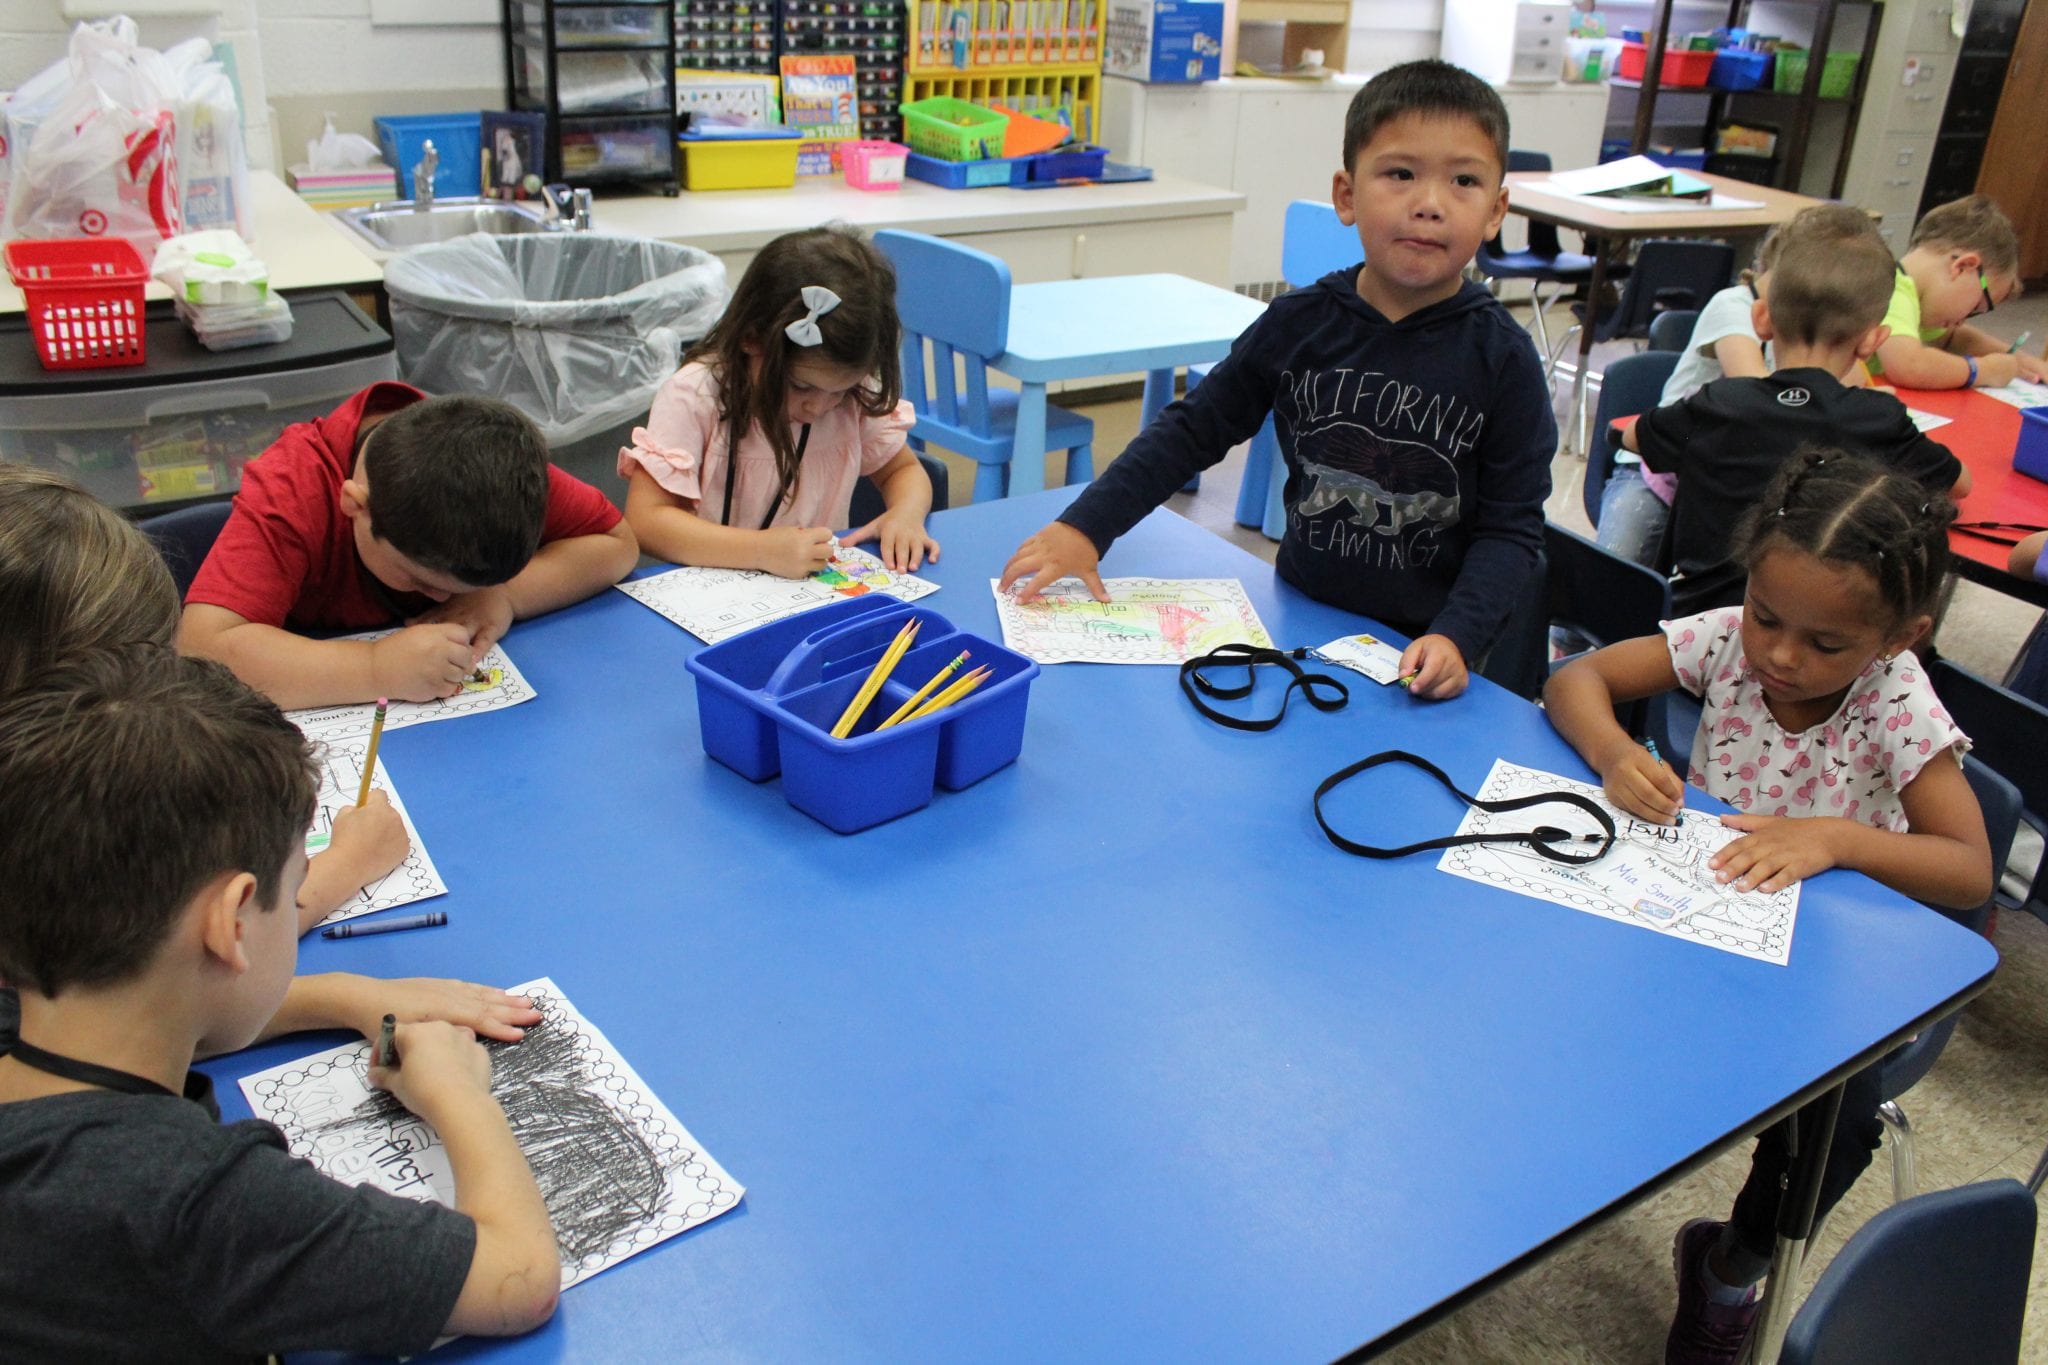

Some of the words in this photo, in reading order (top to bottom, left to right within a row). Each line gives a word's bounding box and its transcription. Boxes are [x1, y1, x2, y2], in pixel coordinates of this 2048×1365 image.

[1609, 863, 1638, 885] Mia
[1645, 883, 1692, 912] Smith
[1645, 857, 1658, 868] My
[1661, 866, 1688, 885] Name
[369, 1139, 434, 1191] first
